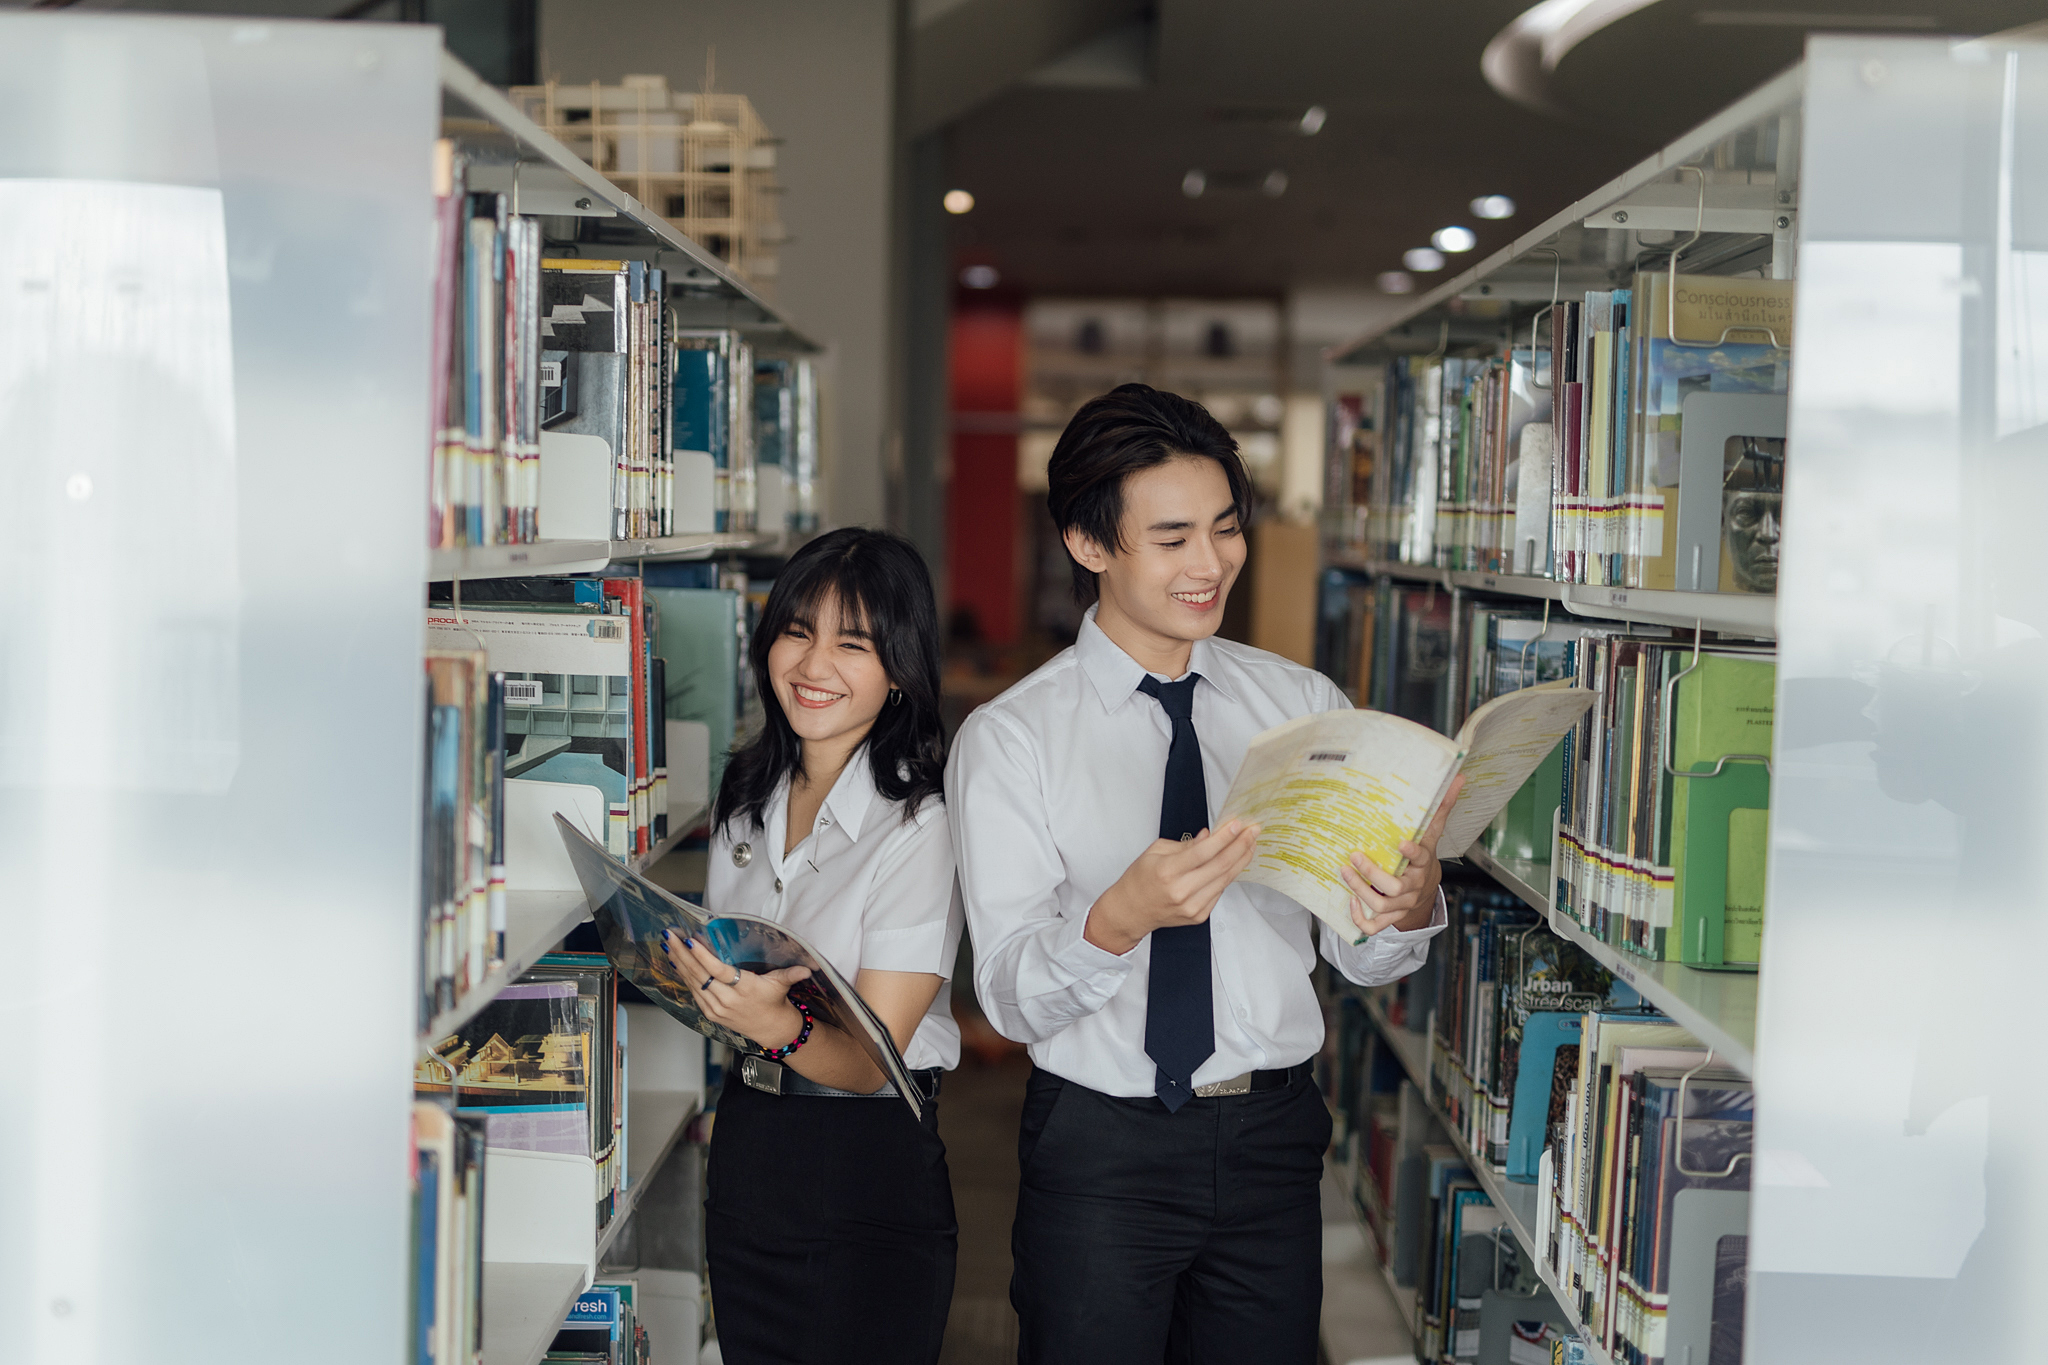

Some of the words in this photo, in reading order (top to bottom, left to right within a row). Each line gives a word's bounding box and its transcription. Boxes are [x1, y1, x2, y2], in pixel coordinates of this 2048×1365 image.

[1675, 289, 1791, 309] Consciousness
[427, 617, 469, 625] PROCES
[574, 1299, 607, 1312] resh
